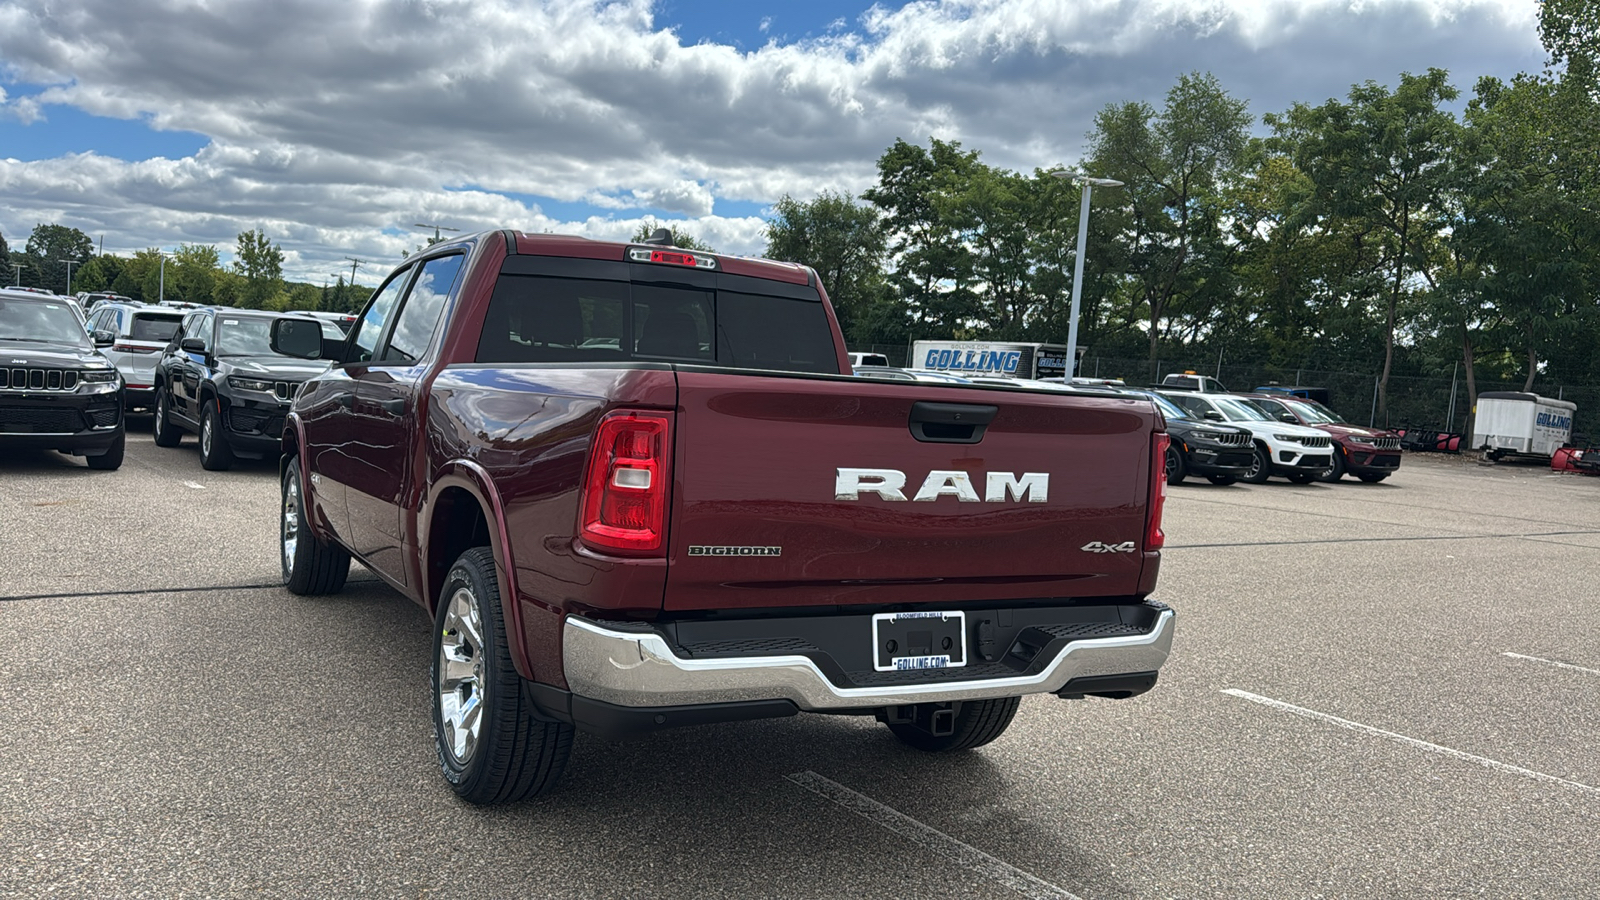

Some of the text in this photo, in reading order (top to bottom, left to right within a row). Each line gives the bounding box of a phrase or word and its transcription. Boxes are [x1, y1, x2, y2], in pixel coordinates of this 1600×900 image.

[925, 349, 1022, 373] GOLLING
[1536, 412, 1571, 430] GOLLING
[835, 467, 1050, 502] RAM
[687, 545, 782, 557] BIGHORN
[1080, 541, 1136, 553] 4x4
[897, 656, 947, 670] GOLLING.COM
